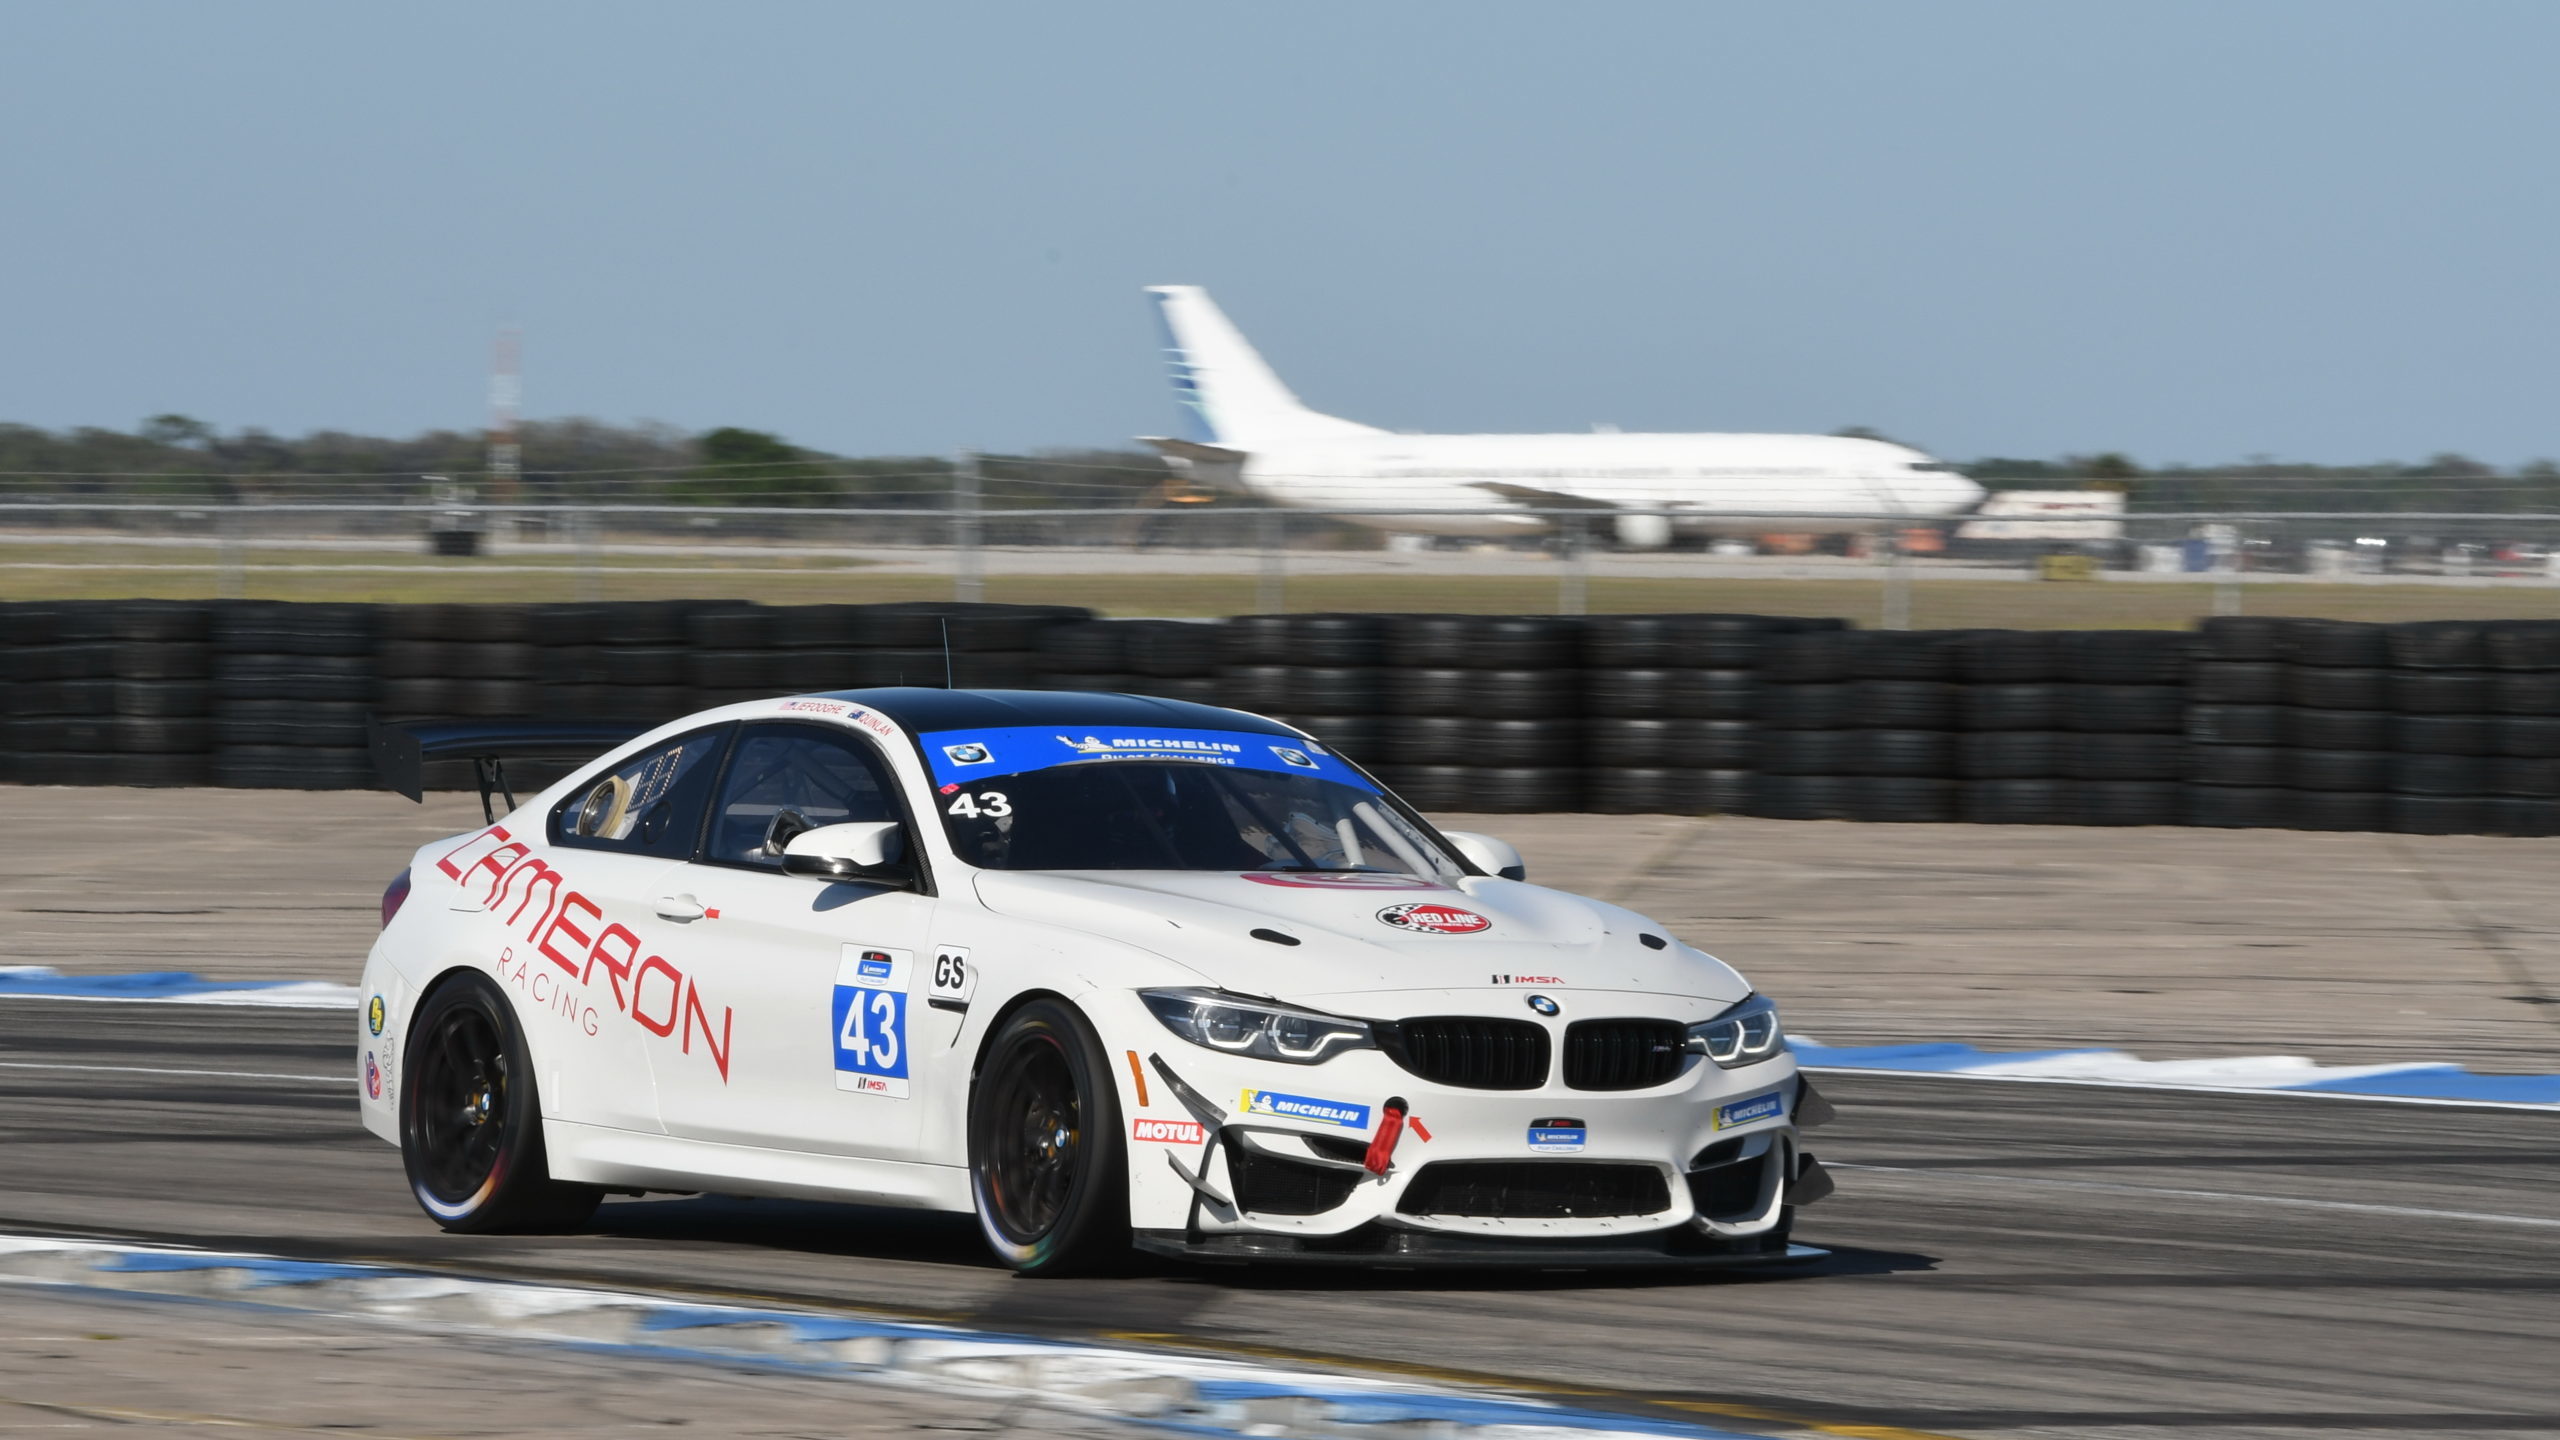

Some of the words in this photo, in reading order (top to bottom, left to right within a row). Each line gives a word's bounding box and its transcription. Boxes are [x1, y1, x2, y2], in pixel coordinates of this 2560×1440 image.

[859, 713, 894, 736] QUINLAN
[1111, 738, 1241, 753] MICHELIN
[948, 791, 1012, 819] 43
[1409, 913, 1442, 924] RED
[1443, 913, 1483, 925] LINE
[436, 825, 732, 1087] CAMERON
[934, 954, 965, 989] GS
[1515, 976, 1566, 985] IMSA
[496, 946, 599, 1037] RACING
[840, 990, 899, 1070] 43
[867, 1080, 888, 1092] IMSA
[1276, 1101, 1360, 1122] MICHELIN
[1733, 1100, 1777, 1120] MICHELIN
[1135, 1122, 1200, 1142] MOTUL
